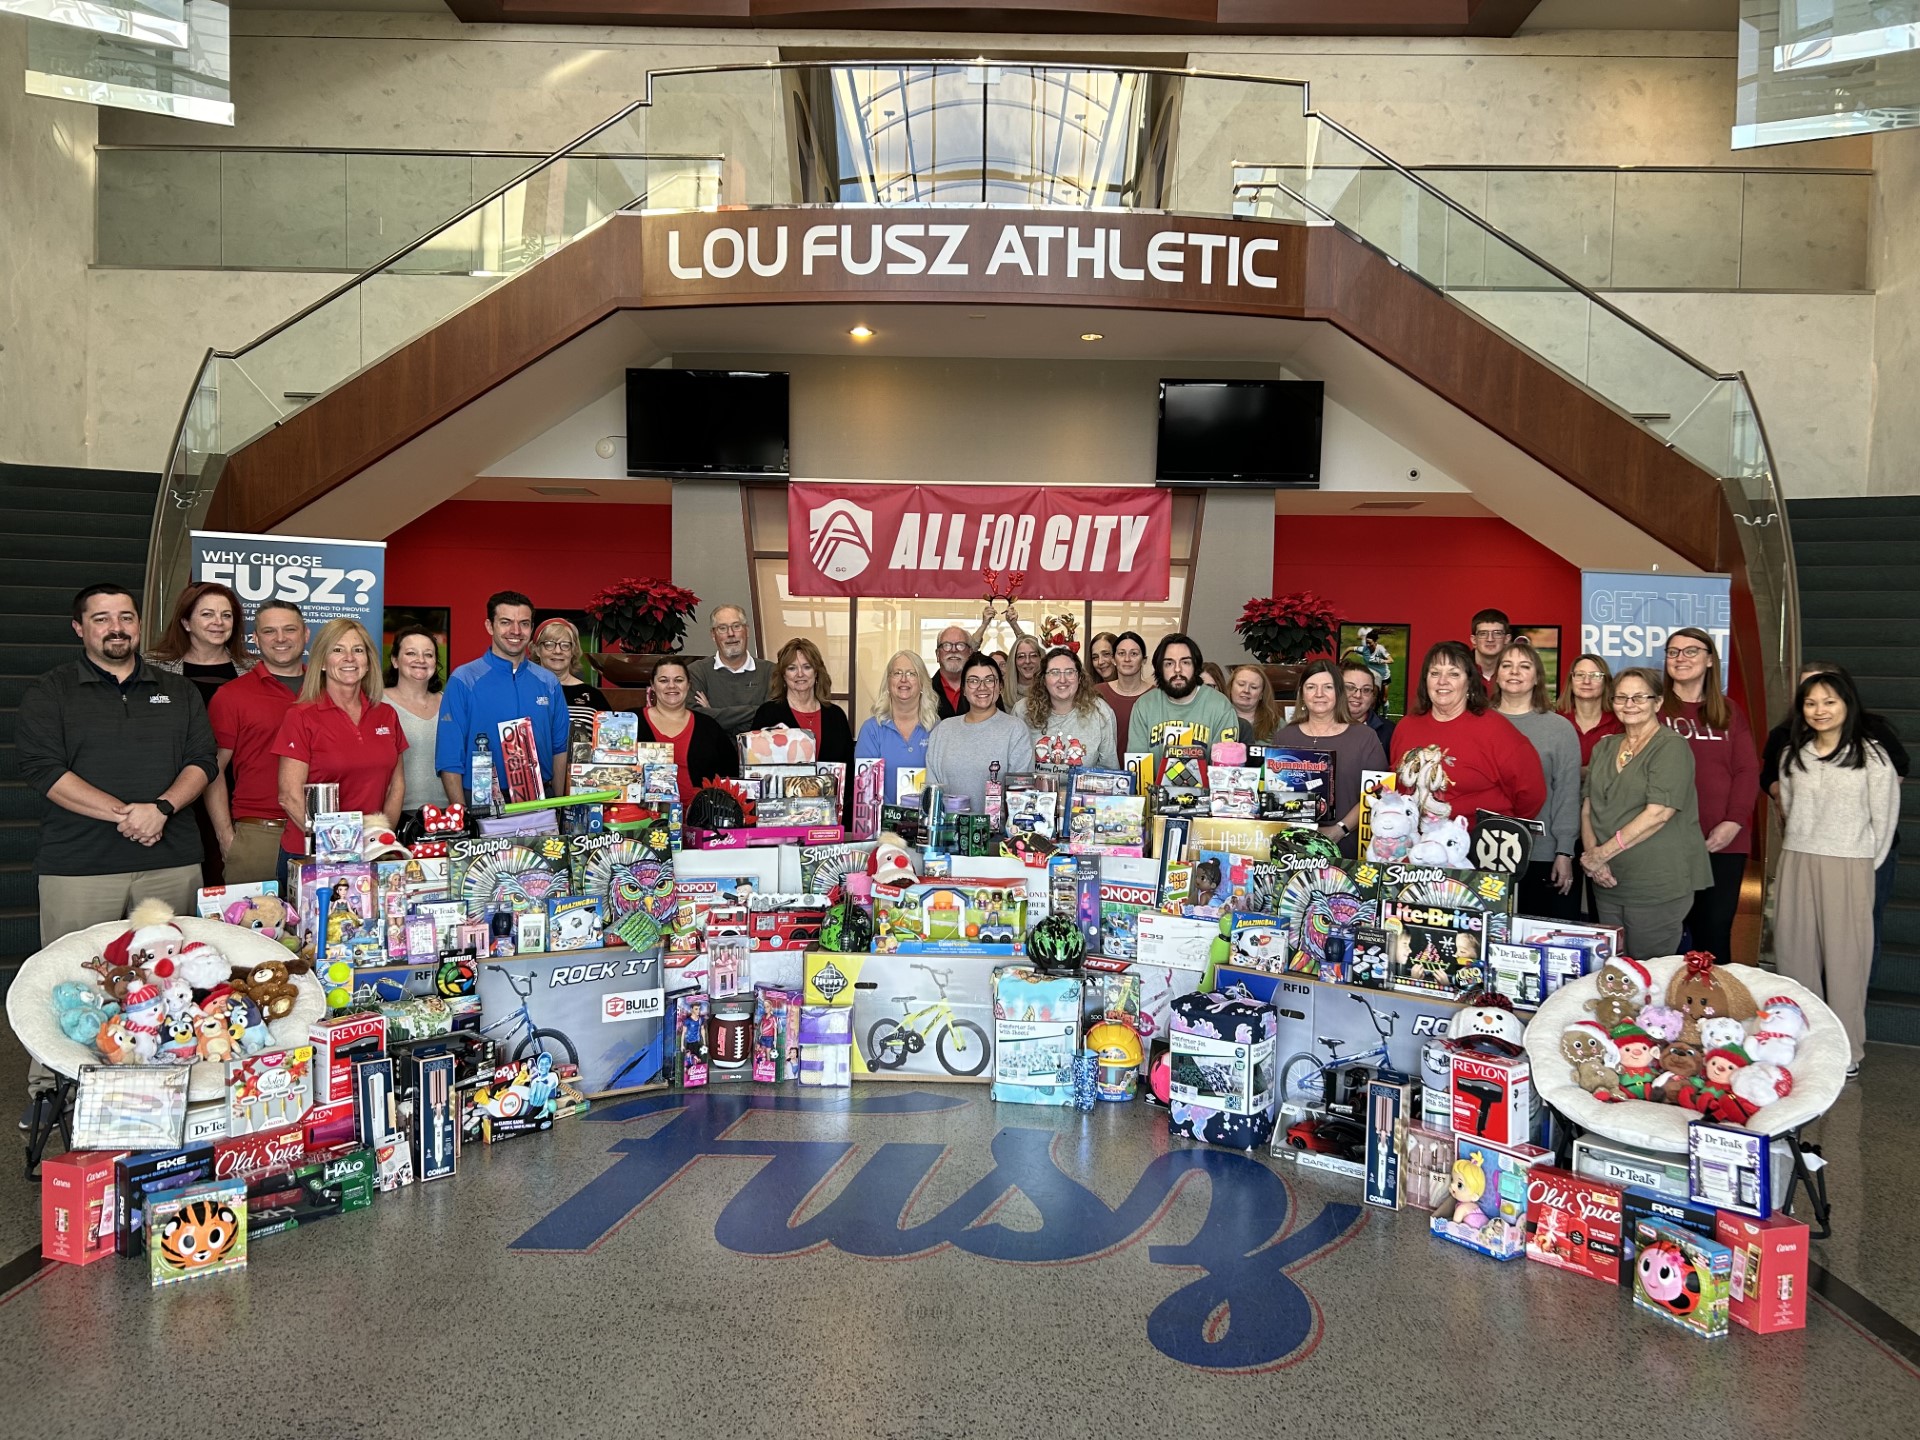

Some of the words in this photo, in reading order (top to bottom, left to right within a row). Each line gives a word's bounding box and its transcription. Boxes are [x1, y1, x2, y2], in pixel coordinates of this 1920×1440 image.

[668, 227, 788, 279] LOU
[803, 224, 970, 275] FUSZ
[985, 225, 1279, 289] ATHLETIC
[888, 512, 967, 571] ALL
[972, 513, 1033, 571] FOR
[1039, 514, 1150, 573] CITY
[201, 550, 246, 564] WHY
[250, 552, 323, 568] CHOOSE
[201, 562, 377, 605] FUSZ?
[1589, 589, 1659, 624] GET
[1666, 592, 1730, 627] THE
[1581, 624, 1730, 660] RESPT
[1267, 758, 1328, 774] Rummikub
[543, 839, 564, 852] 27
[571, 831, 623, 855] Sharpie
[651, 831, 668, 844] 27
[450, 837, 511, 861] Sharpie
[802, 843, 850, 866] Sharpie
[1276, 853, 1329, 872] Sharpie
[1168, 873, 1188, 883] SKIP
[1357, 865, 1376, 881] 27
[1383, 865, 1446, 885] Sharpie
[675, 882, 717, 893] NOPOLY
[1173, 880, 1187, 891] BO
[1483, 878, 1501, 892] 27
[1101, 886, 1156, 904] ONOPOL
[679, 906, 693, 917] KIP
[680, 915, 692, 926] BO
[443, 954, 473, 963] simon
[1083, 958, 1122, 969] HUFFY
[549, 961, 620, 988] ROCK
[622, 958, 657, 976] IT
[815, 976, 846, 986] HUFFY
[1283, 982, 1310, 995] RFID
[607, 1001, 624, 1012] EZ
[625, 997, 659, 1011] BUILD
[331, 1020, 383, 1041] REVLON
[1412, 1014, 1450, 1037] RO
[1454, 1060, 1508, 1082] REVLON
[194, 1124, 209, 1136] Dr
[209, 1117, 226, 1131] Tea
[1705, 1133, 1719, 1144] Dr
[156, 1155, 187, 1171] AXE
[215, 1149, 254, 1177] Old
[265, 1141, 305, 1167] Spice
[1302, 1157, 1330, 1169] DARK
[86, 1169, 108, 1183] Caress
[325, 1160, 364, 1181] HALO
[426, 1166, 450, 1177] CONAIR
[1610, 1165, 1626, 1179] Dr
[52, 1177, 72, 1188] Caress
[1432, 1175, 1446, 1183] SET
[1368, 1195, 1392, 1206] CONAIR
[1526, 1180, 1566, 1208] Old
[1576, 1192, 1622, 1224] Spice
[1651, 1202, 1685, 1219] AXE
[1776, 1243, 1797, 1253] Caress
